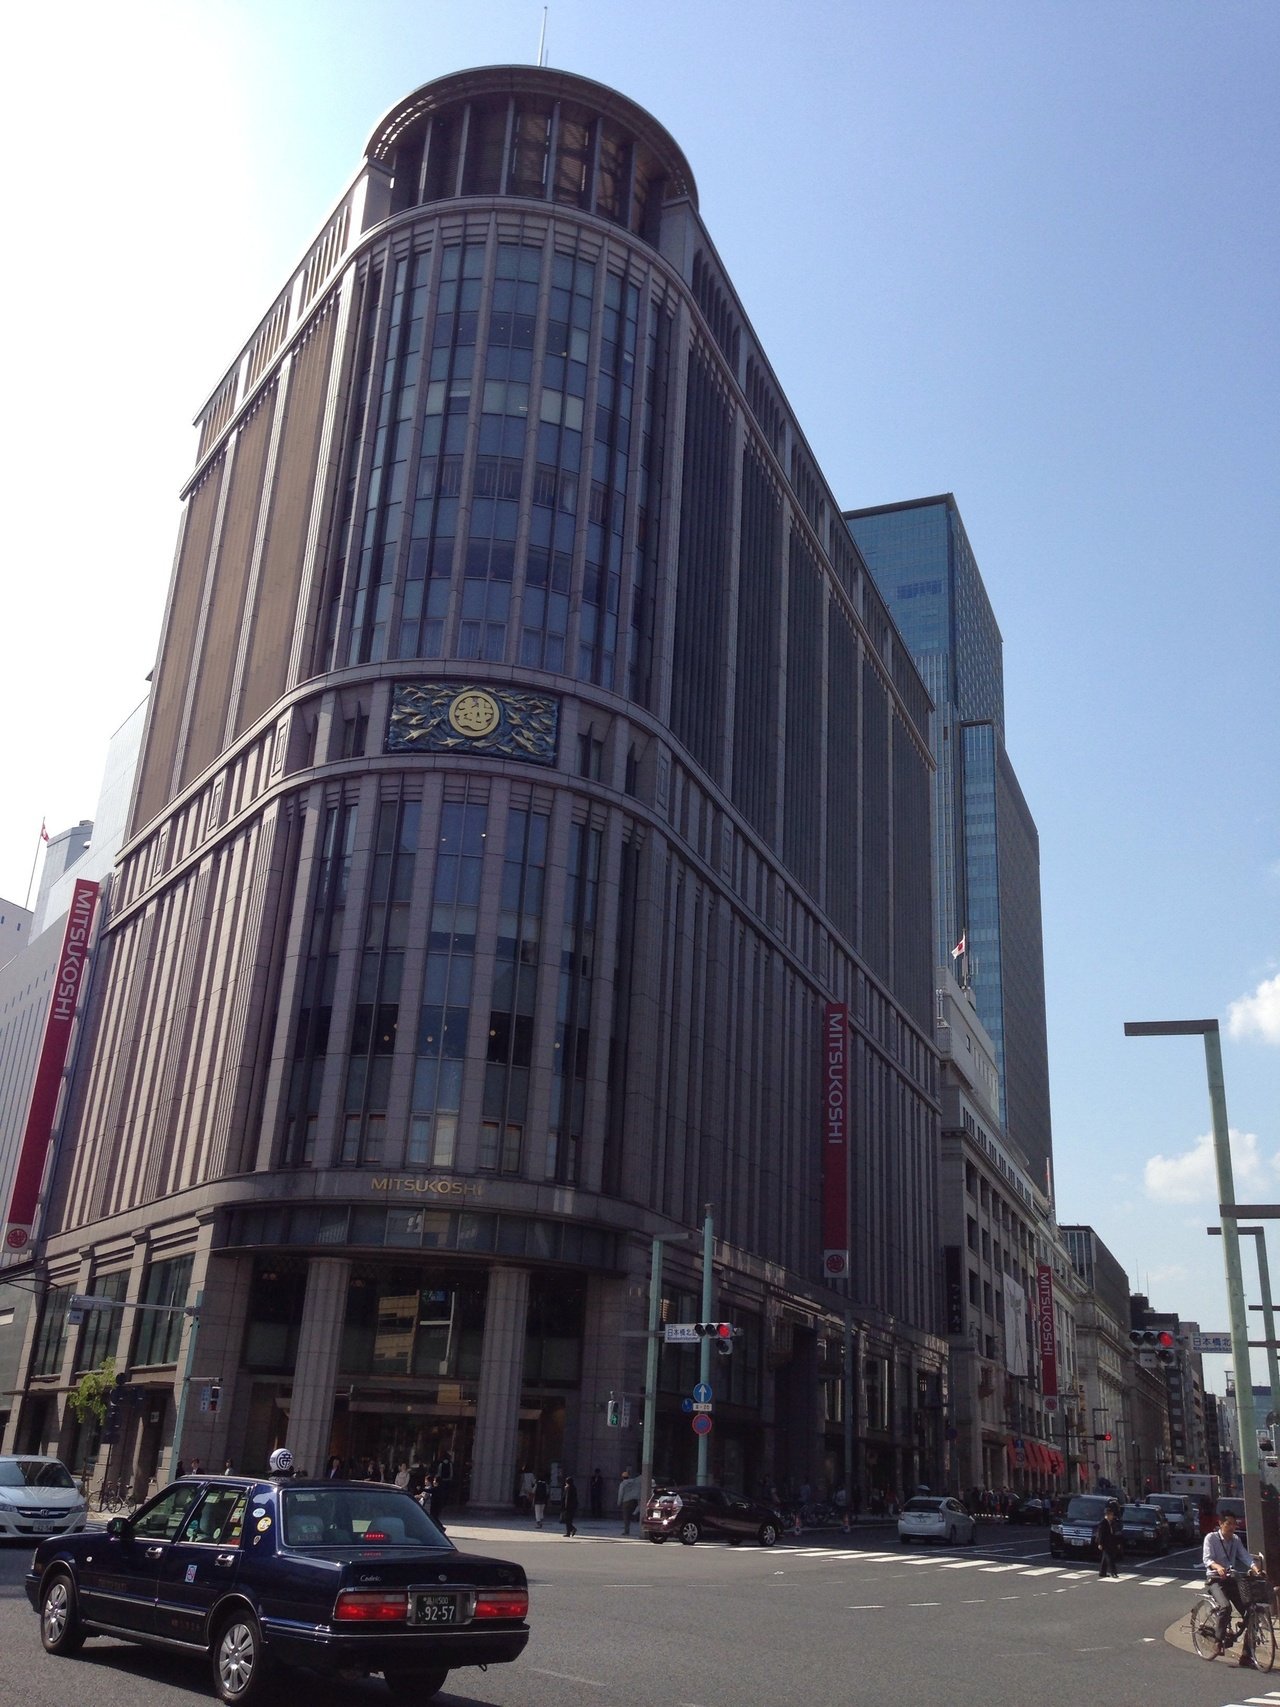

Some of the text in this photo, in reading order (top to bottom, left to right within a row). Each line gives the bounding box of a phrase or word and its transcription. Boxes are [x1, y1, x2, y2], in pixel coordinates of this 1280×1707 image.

[53, 889, 94, 1021] MITSUKOSHI
[829, 1013, 843, 1144] MITSUKOSHI
[371, 1178, 484, 1196] MITSUKOSHI
[1040, 1272, 1053, 1356] MITSUKOSHI
[424, 1605, 455, 1621] 92-57
